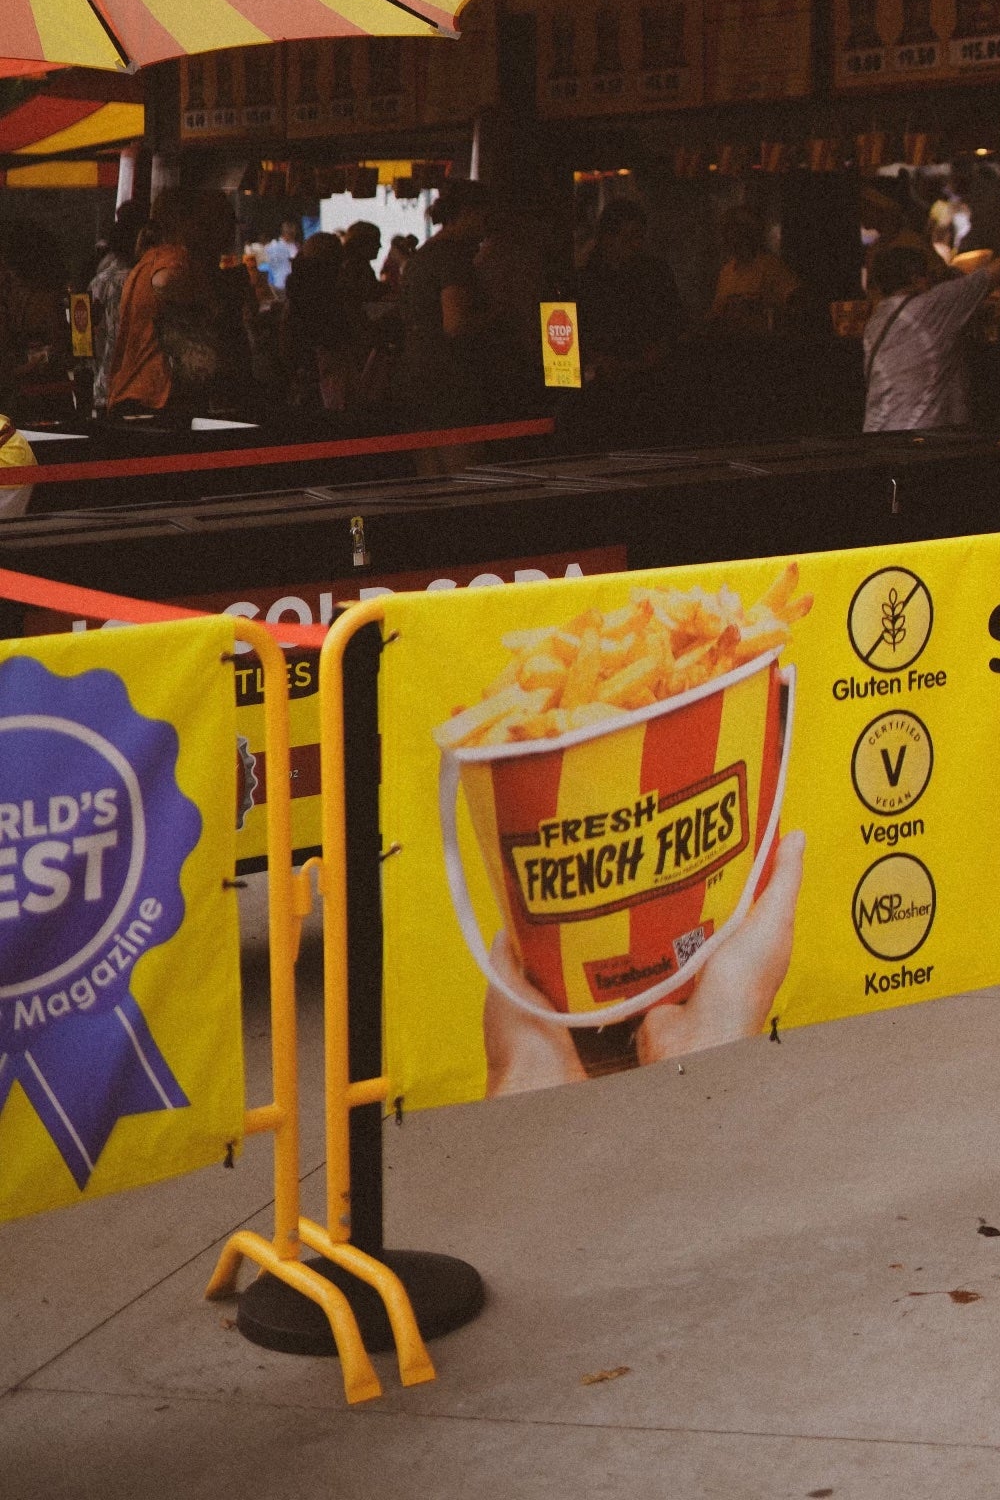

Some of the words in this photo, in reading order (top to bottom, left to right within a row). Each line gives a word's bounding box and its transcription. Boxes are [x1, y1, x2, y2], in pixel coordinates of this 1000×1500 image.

[549, 324, 572, 336] STOP
[832, 676, 902, 701] Gluten
[907, 669, 947, 692] Free
[868, 720, 922, 746] CERTIFIED
[880, 745, 907, 787] V
[875, 790, 912, 808] VEGAN
[541, 795, 656, 848] FRESH
[860, 818, 925, 847] Vegan
[524, 835, 645, 902] FRENCH
[654, 790, 737, 875] FRIES
[0, 829, 118, 920] EST
[13, 896, 164, 1031] Magazine
[864, 965, 934, 996] Kosher
